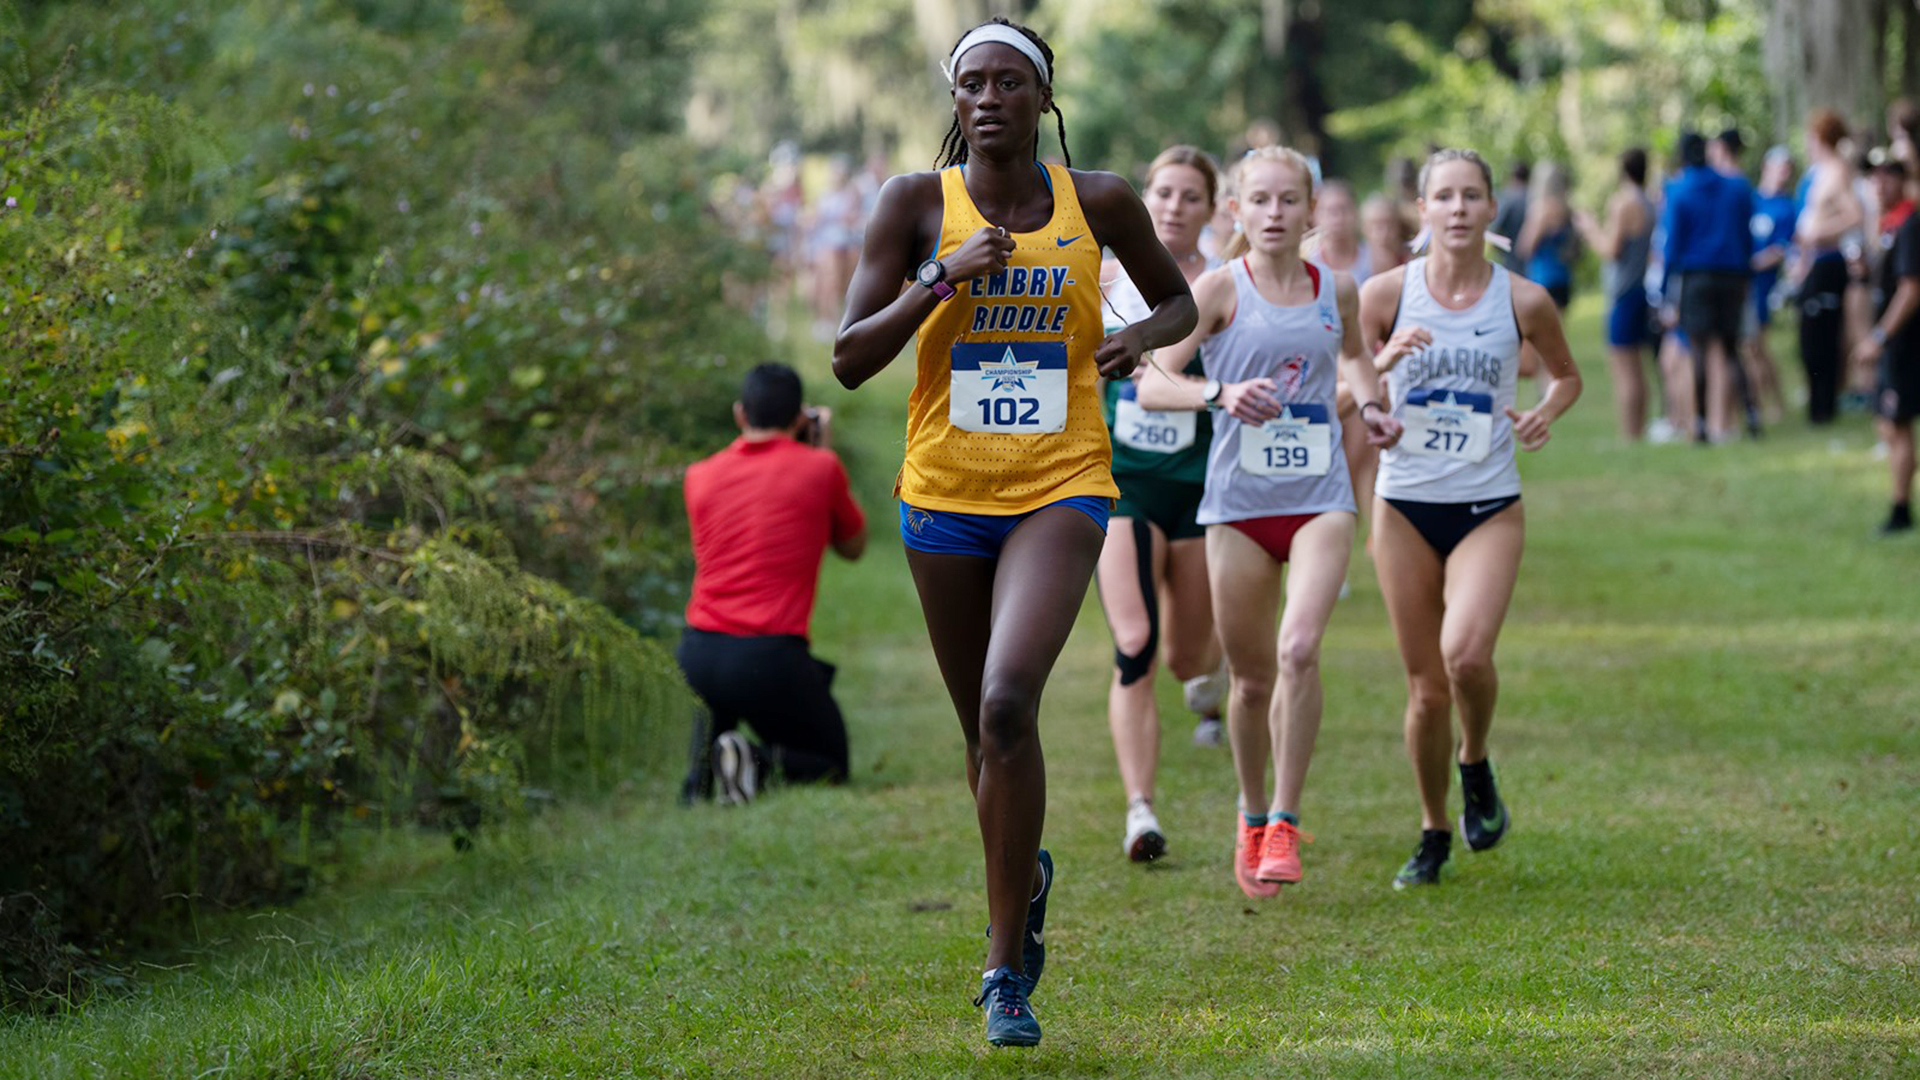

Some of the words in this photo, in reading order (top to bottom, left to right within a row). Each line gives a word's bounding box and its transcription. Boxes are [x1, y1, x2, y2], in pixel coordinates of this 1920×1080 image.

[970, 266, 1075, 297] EMBRY-
[971, 305, 1070, 333] RIDDLE
[1406, 349, 1502, 387] SHARKS
[977, 398, 1040, 425] 102
[1131, 422, 1178, 446] 260
[1424, 428, 1469, 452] 217
[1263, 446, 1309, 468] 139
